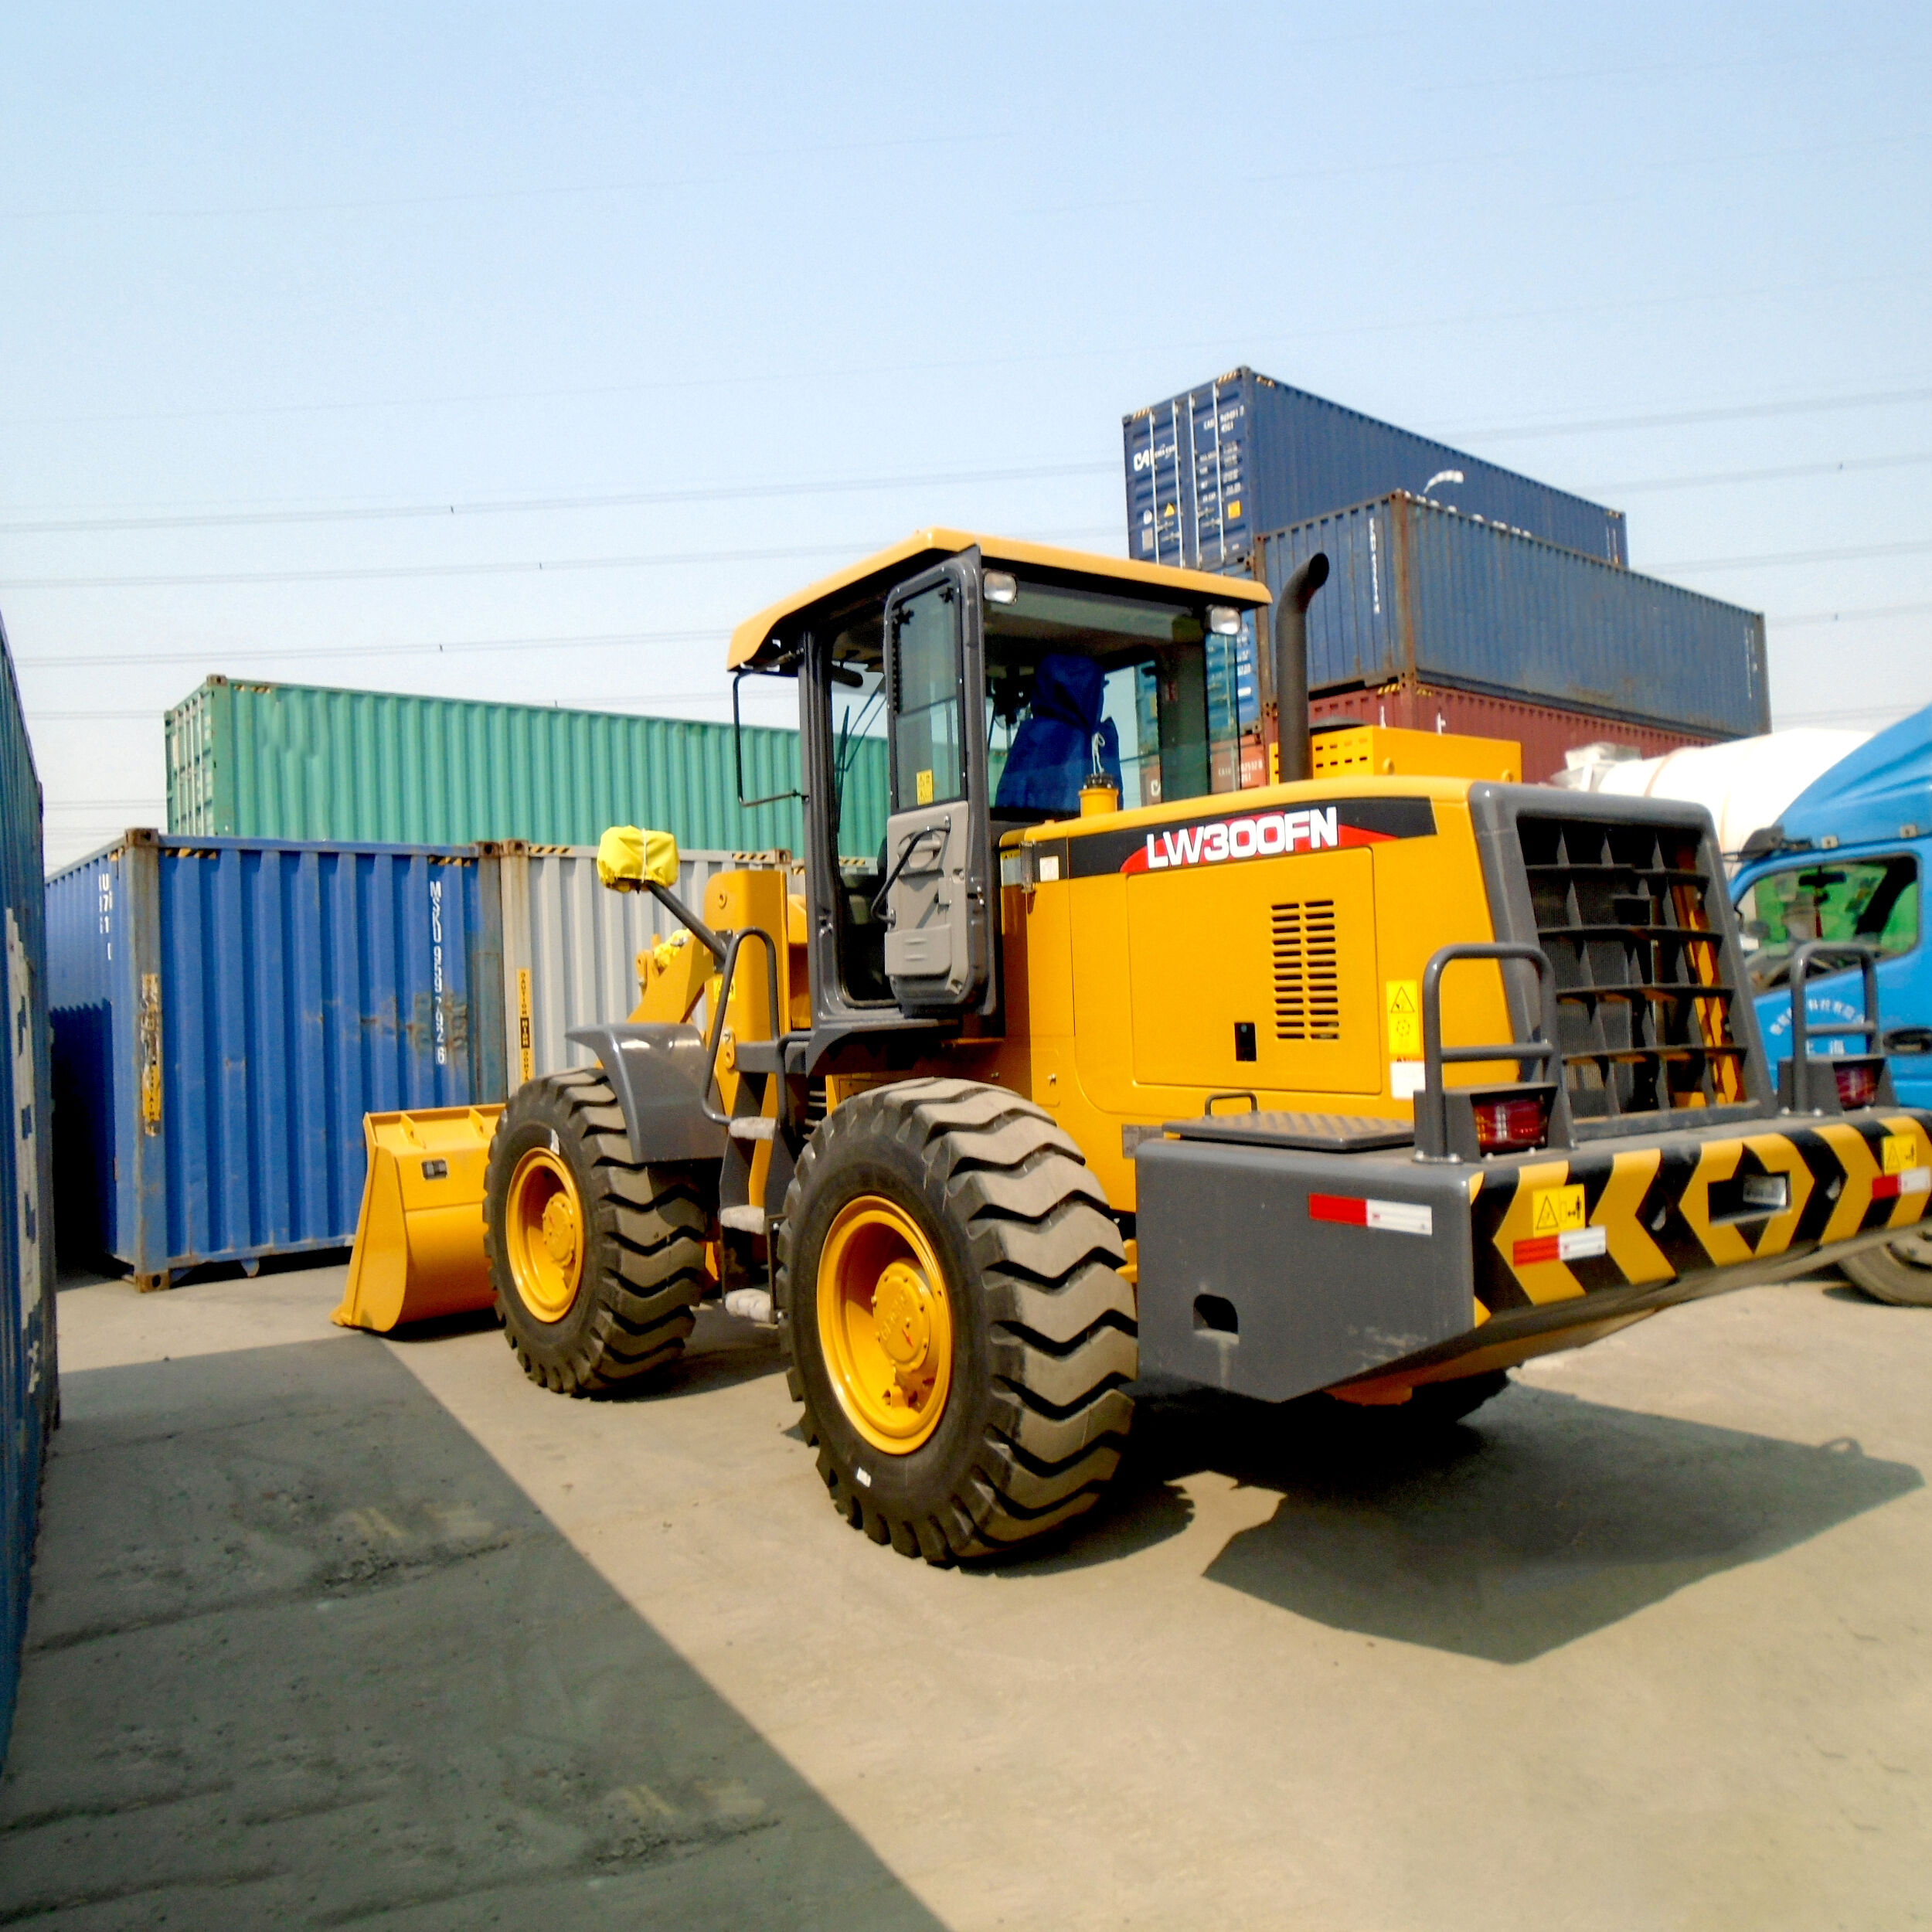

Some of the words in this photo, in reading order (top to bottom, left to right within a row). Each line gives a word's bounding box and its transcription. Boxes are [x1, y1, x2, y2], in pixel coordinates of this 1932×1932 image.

[1147, 806, 1338, 869] LW300FN
[430, 880, 441, 943] MSKU
[437, 1046, 446, 1065] 6
